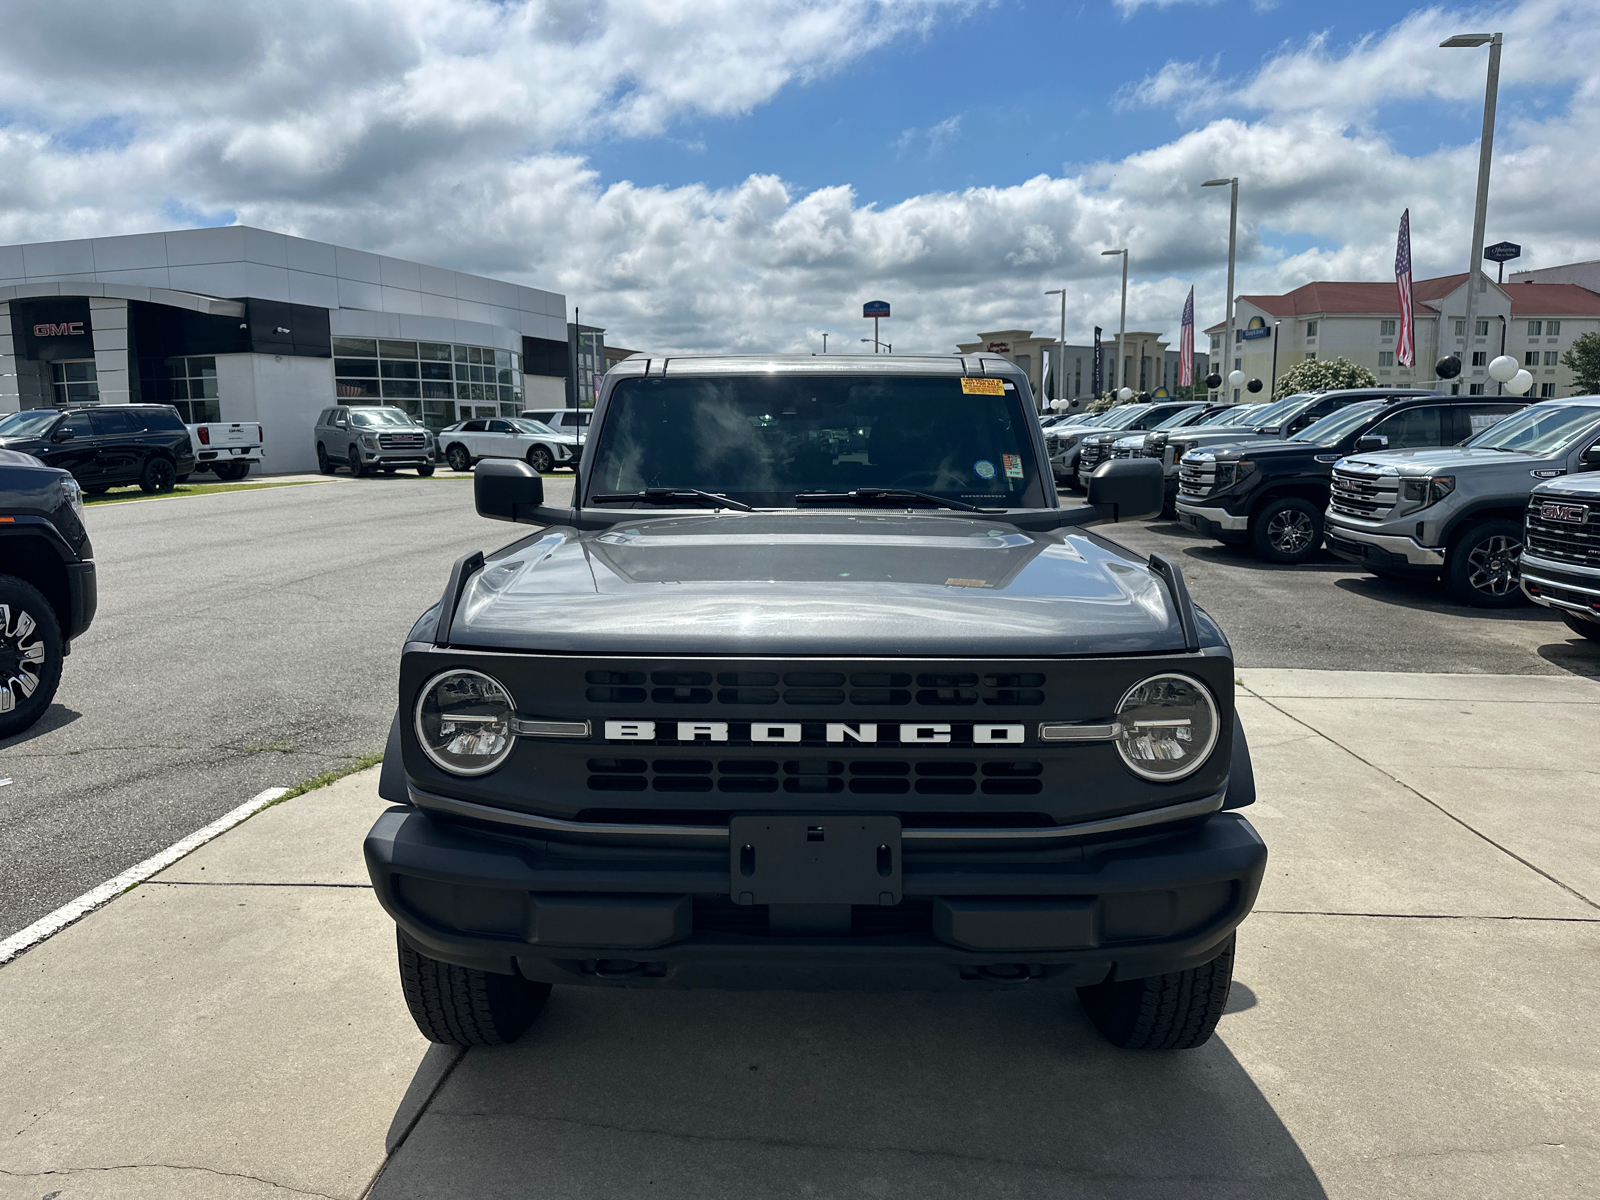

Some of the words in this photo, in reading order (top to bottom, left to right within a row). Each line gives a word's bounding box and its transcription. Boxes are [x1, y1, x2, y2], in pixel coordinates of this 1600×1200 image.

[34, 322, 85, 337] GMC
[1340, 479, 1363, 492] GMC
[1541, 505, 1583, 522] GMC
[604, 720, 1025, 743] BRONCO
